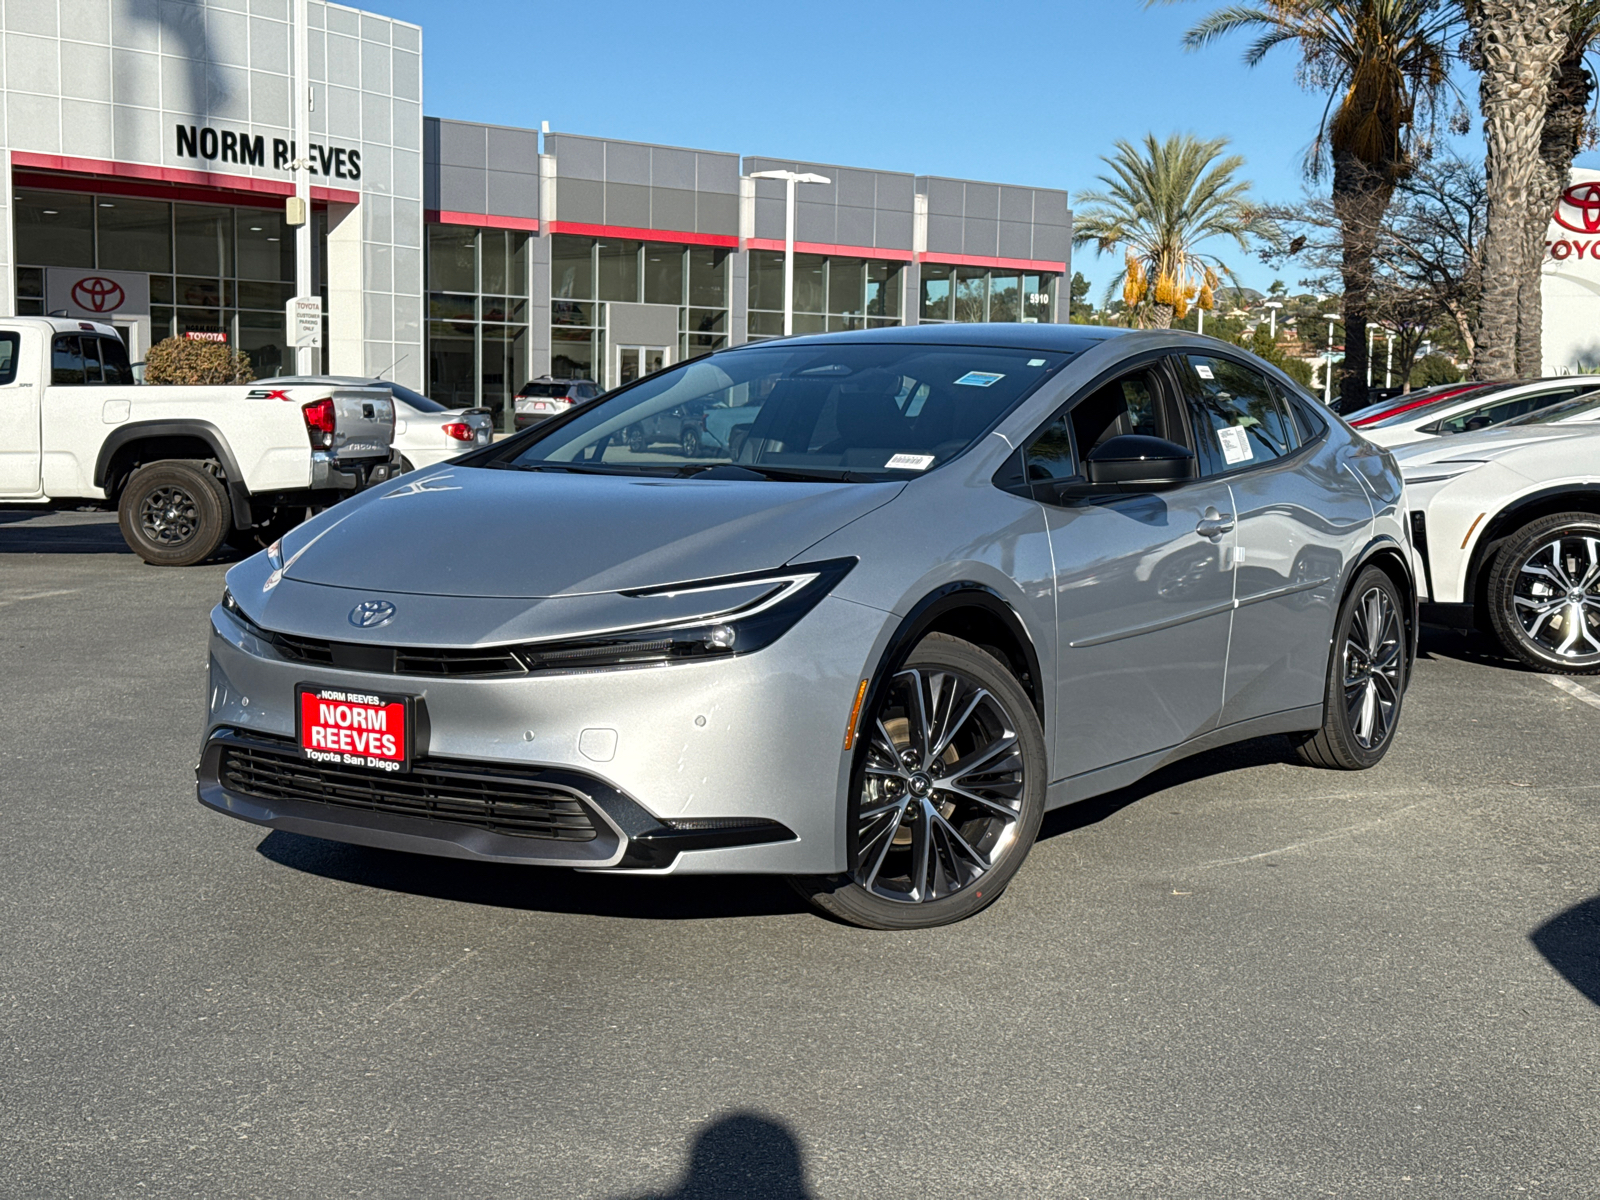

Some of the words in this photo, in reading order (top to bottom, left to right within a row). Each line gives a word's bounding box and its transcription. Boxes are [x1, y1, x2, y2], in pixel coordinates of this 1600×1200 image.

[176, 124, 265, 167] NORM
[1030, 294, 1049, 304] 5910
[188, 332, 224, 341] TOYOTA
[321, 690, 346, 702] NORM
[347, 693, 380, 705] REEVES
[319, 703, 387, 731] NORM
[311, 726, 397, 756] REEVES
[305, 748, 341, 762] Toyota
[343, 754, 365, 765] San
[367, 757, 400, 771] Diego
